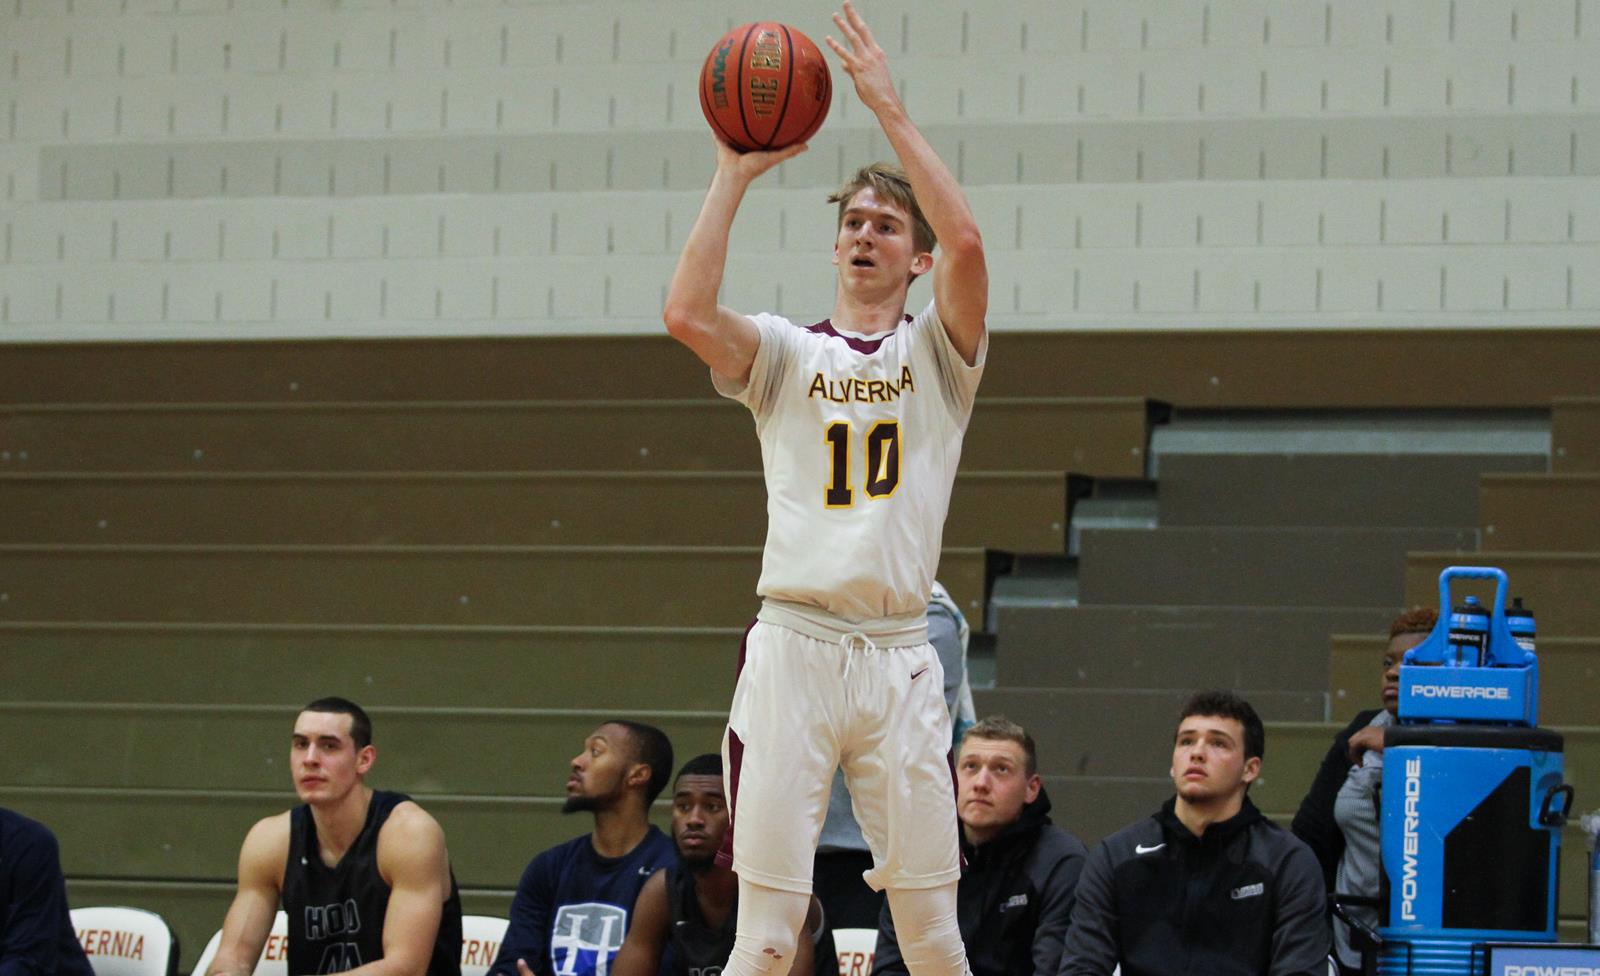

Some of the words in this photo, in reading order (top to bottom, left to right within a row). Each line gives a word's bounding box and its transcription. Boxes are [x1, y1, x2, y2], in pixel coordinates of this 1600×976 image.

[750, 77, 778, 119] THE
[808, 365, 915, 404] ALVERNA
[824, 419, 903, 509] 10
[1411, 685, 1509, 699] POWERADE
[1401, 758, 1421, 921] POWERADE
[78, 929, 145, 961] ERNIA
[1504, 965, 1600, 976] POWER
